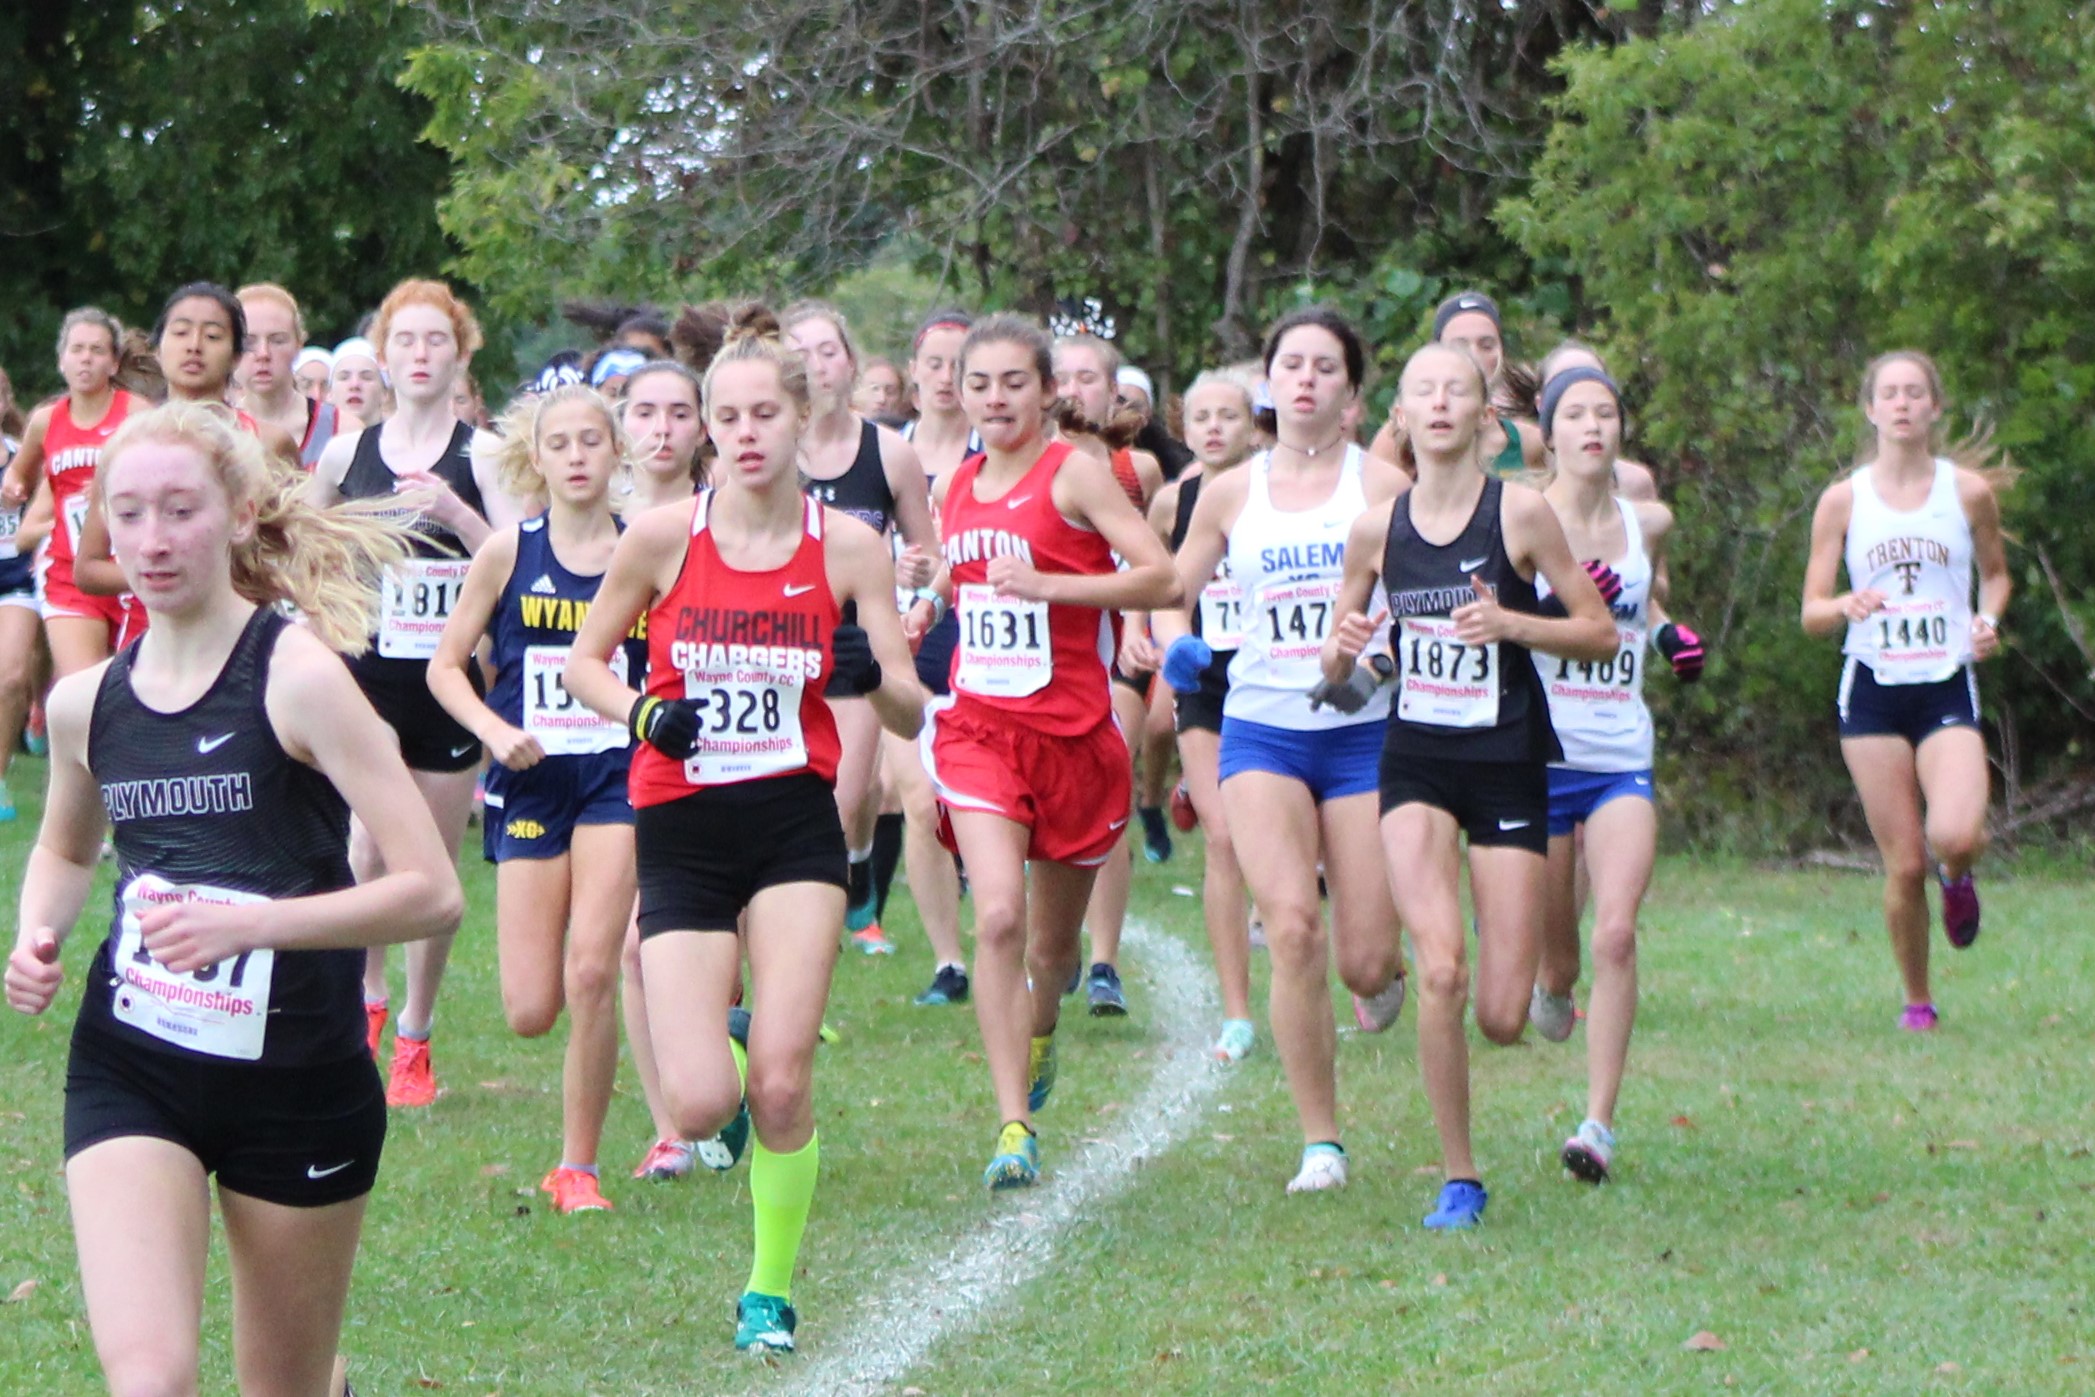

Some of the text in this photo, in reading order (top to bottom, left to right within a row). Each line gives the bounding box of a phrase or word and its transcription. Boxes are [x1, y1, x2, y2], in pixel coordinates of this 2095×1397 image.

[1261, 542, 1345, 574] SALEM
[1866, 536, 1950, 572] TRENTON
[1296, 586, 1328, 600] County
[1390, 583, 1498, 618] PLYMOU
[675, 606, 823, 650] CHURCHILL
[966, 608, 1041, 651] 1631
[1267, 601, 1336, 643] 147
[1880, 615, 1947, 650] 1440
[533, 653, 566, 667] Wayne
[671, 641, 823, 680] CHARGERS
[1408, 637, 1489, 682] 1873
[695, 669, 795, 687] Wayne County CC
[1406, 679, 1489, 699] Championships
[697, 736, 793, 755] Championships
[102, 771, 254, 822] PLYMOUTH
[125, 966, 253, 1018] Championships
